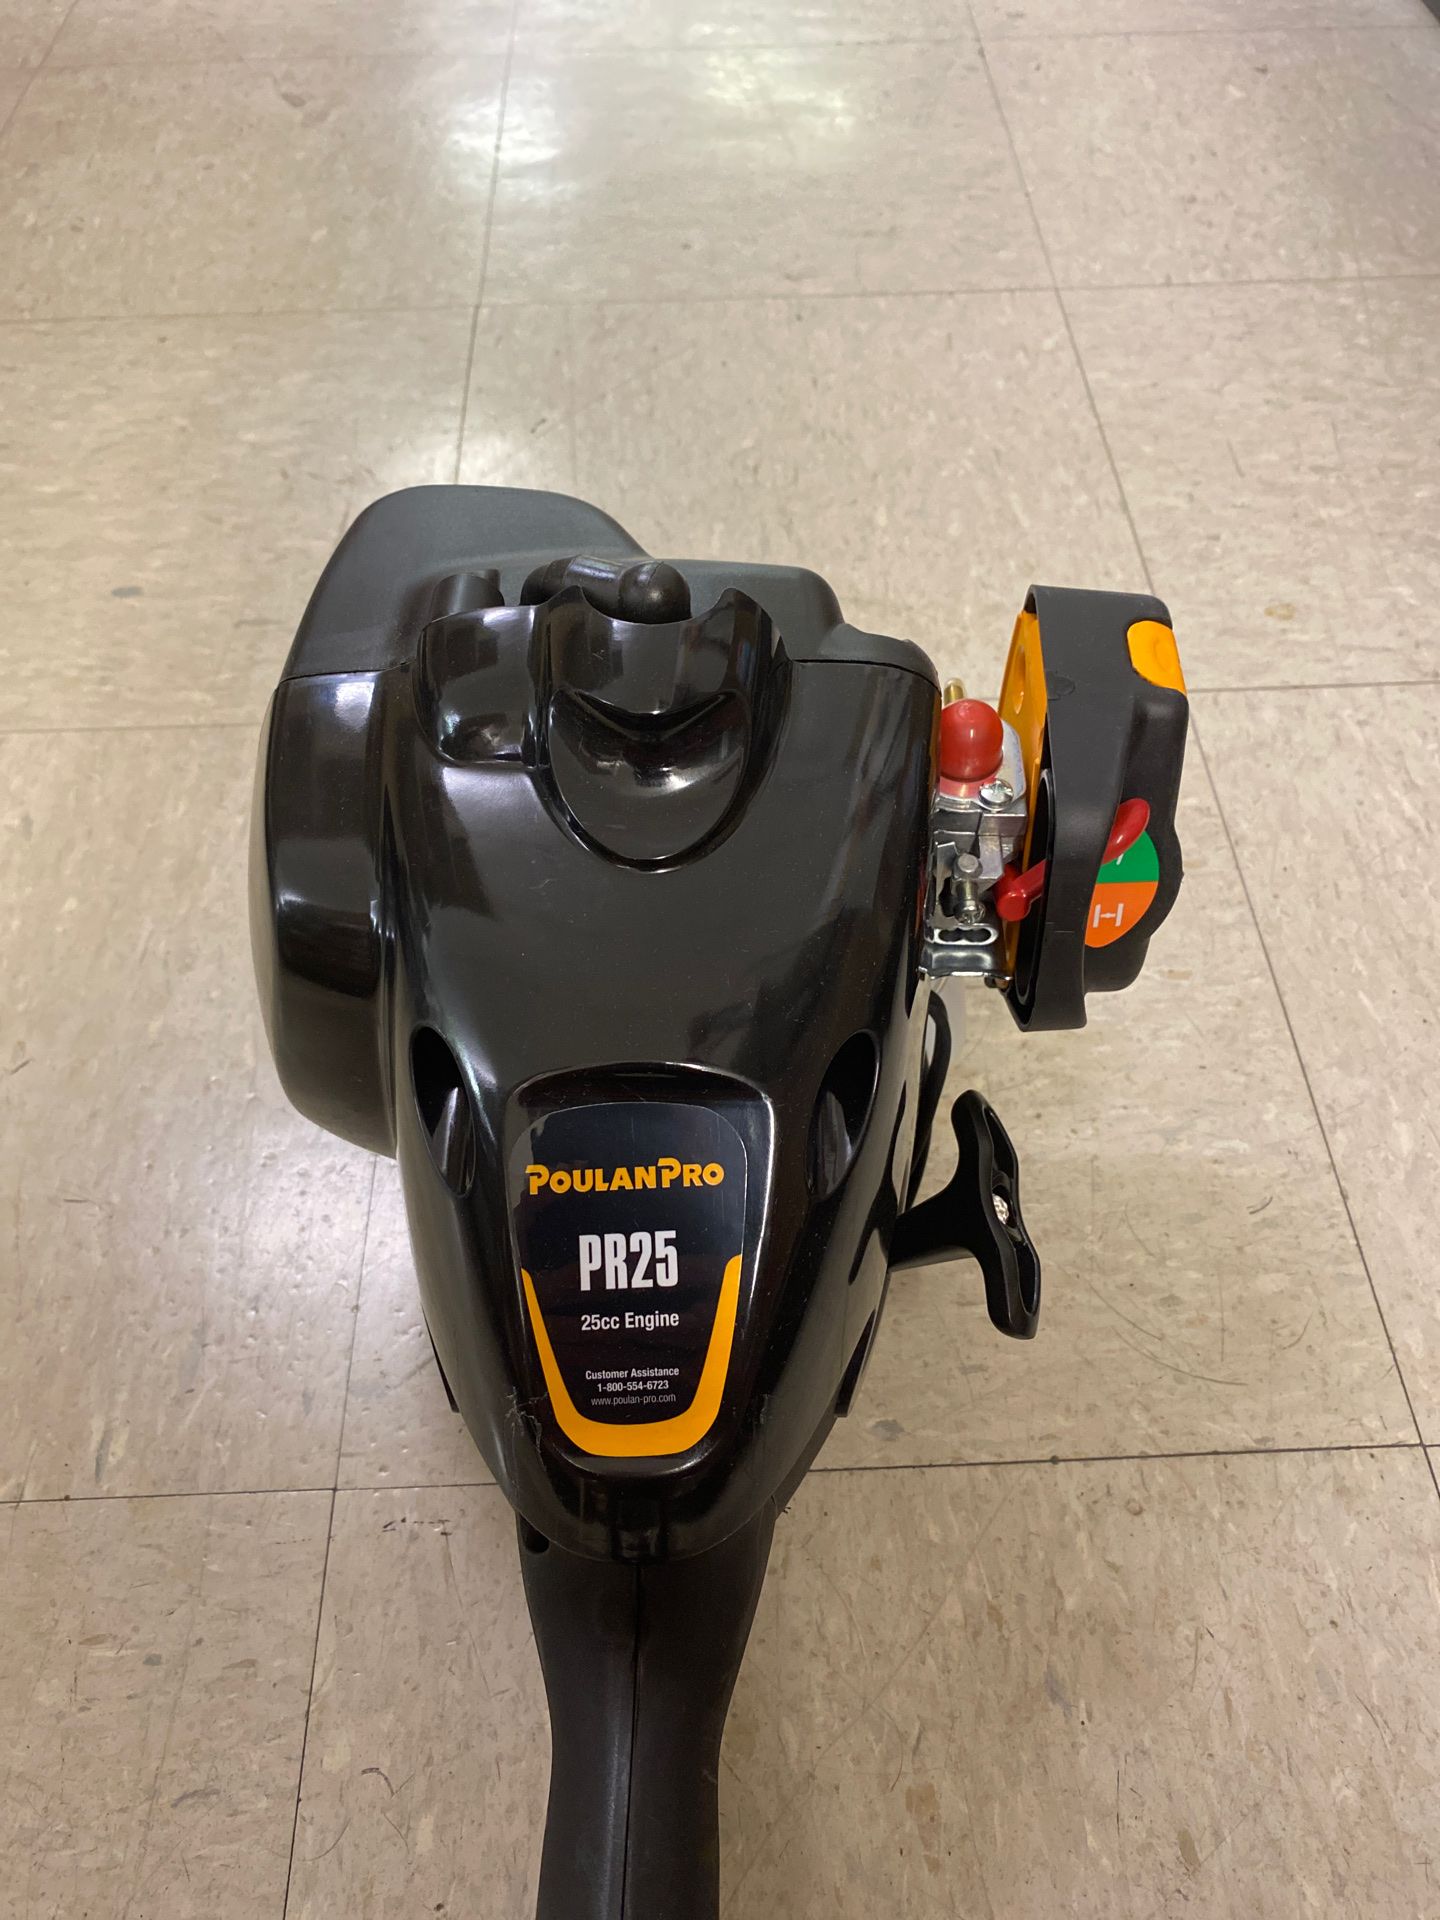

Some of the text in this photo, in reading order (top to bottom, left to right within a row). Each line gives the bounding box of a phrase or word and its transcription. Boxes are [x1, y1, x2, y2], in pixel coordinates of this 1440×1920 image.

[578, 1230, 679, 1292] PR25
[580, 1310, 680, 1331] 25cc Engine
[585, 1367, 680, 1380] Customer Assistance
[597, 1380, 669, 1392] 1-800-554-6723
[590, 1393, 677, 1406] www.poulan-pro.com
